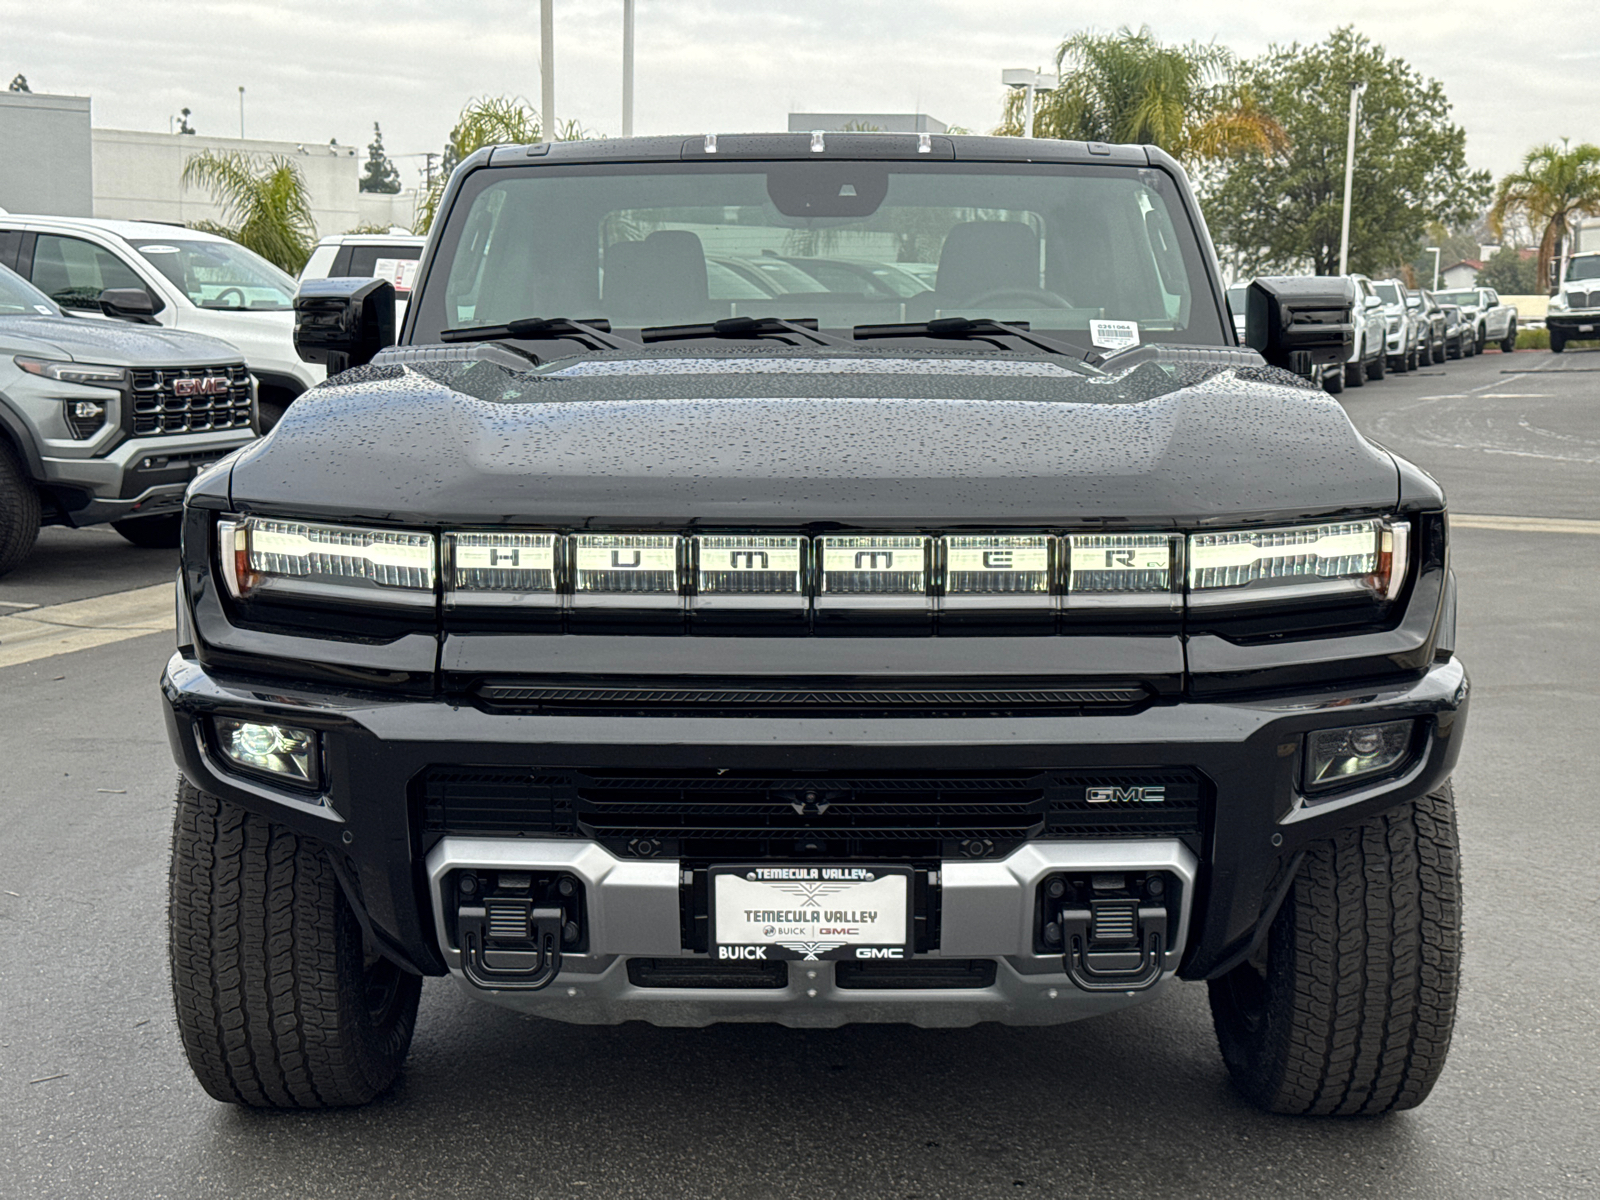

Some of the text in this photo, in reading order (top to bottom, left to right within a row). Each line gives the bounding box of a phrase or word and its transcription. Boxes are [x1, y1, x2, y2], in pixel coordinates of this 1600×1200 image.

[173, 377, 228, 396] GMC
[490, 548, 1135, 569] HUMMER
[1086, 786, 1165, 803] GMC
[756, 868, 867, 880] TEMECULA VALLEY
[744, 910, 878, 924] TEMECULA VALLEY
[778, 927, 860, 936] BUICK GMC
[718, 946, 768, 960] BUICK
[855, 947, 905, 959] GMC
